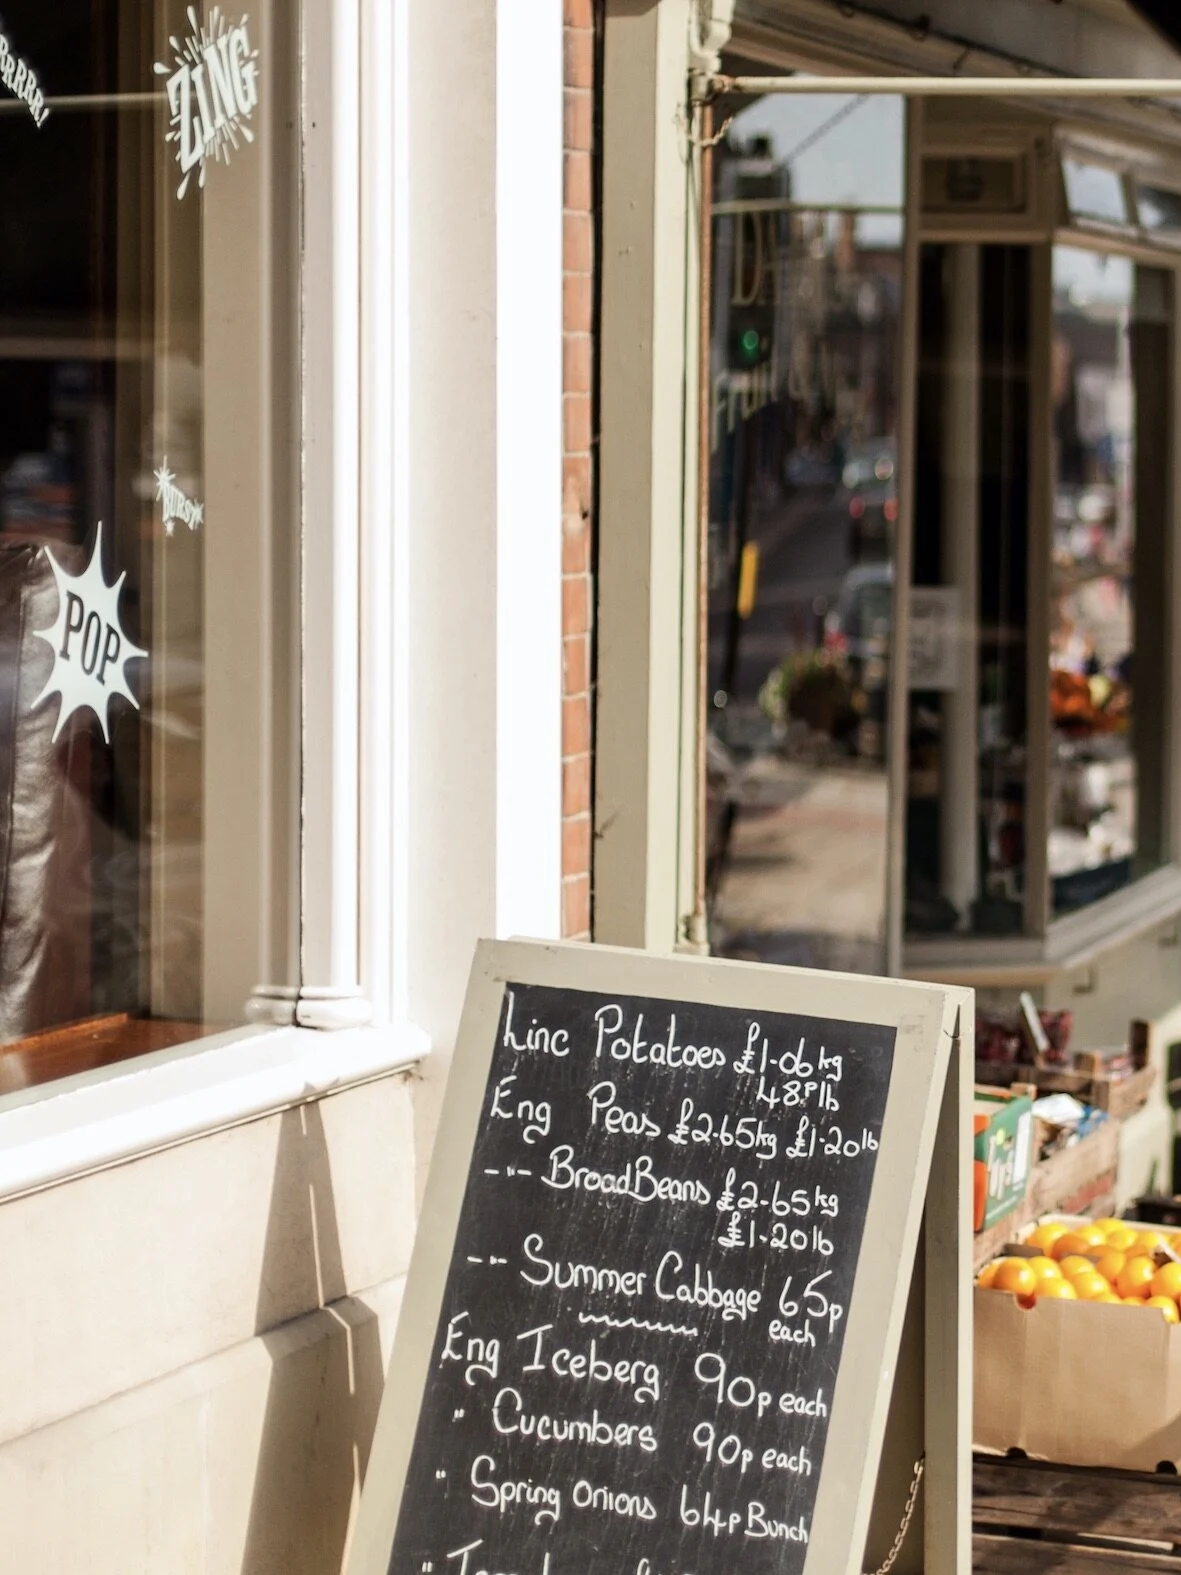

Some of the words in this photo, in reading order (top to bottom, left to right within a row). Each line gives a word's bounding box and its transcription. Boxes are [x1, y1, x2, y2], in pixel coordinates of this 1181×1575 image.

[166, 26, 258, 174] ZING
[59, 590, 121, 686] POP
[503, 991, 570, 1057] Linc
[595, 1004, 726, 1069] Potatoes
[490, 1075, 551, 1144] Eng
[586, 1081, 661, 1138] Peas
[520, 1233, 647, 1295] Summer
[655, 1251, 761, 1321] Cabbage
[779, 1270, 843, 1333] 65p
[441, 1311, 500, 1386] Eng
[516, 1324, 660, 1404] Iceberg
[695, 1353, 772, 1417] 90p
[779, 1388, 827, 1417] each
[769, 1319, 816, 1347] each
[492, 1387, 657, 1452] Cucumbers
[693, 1422, 753, 1473] 90p
[762, 1446, 812, 1476] each
[471, 1455, 561, 1525] Spring
[573, 1480, 657, 1520] Onions
[680, 1484, 741, 1536] 64p
[744, 1502, 808, 1543] Bunch
